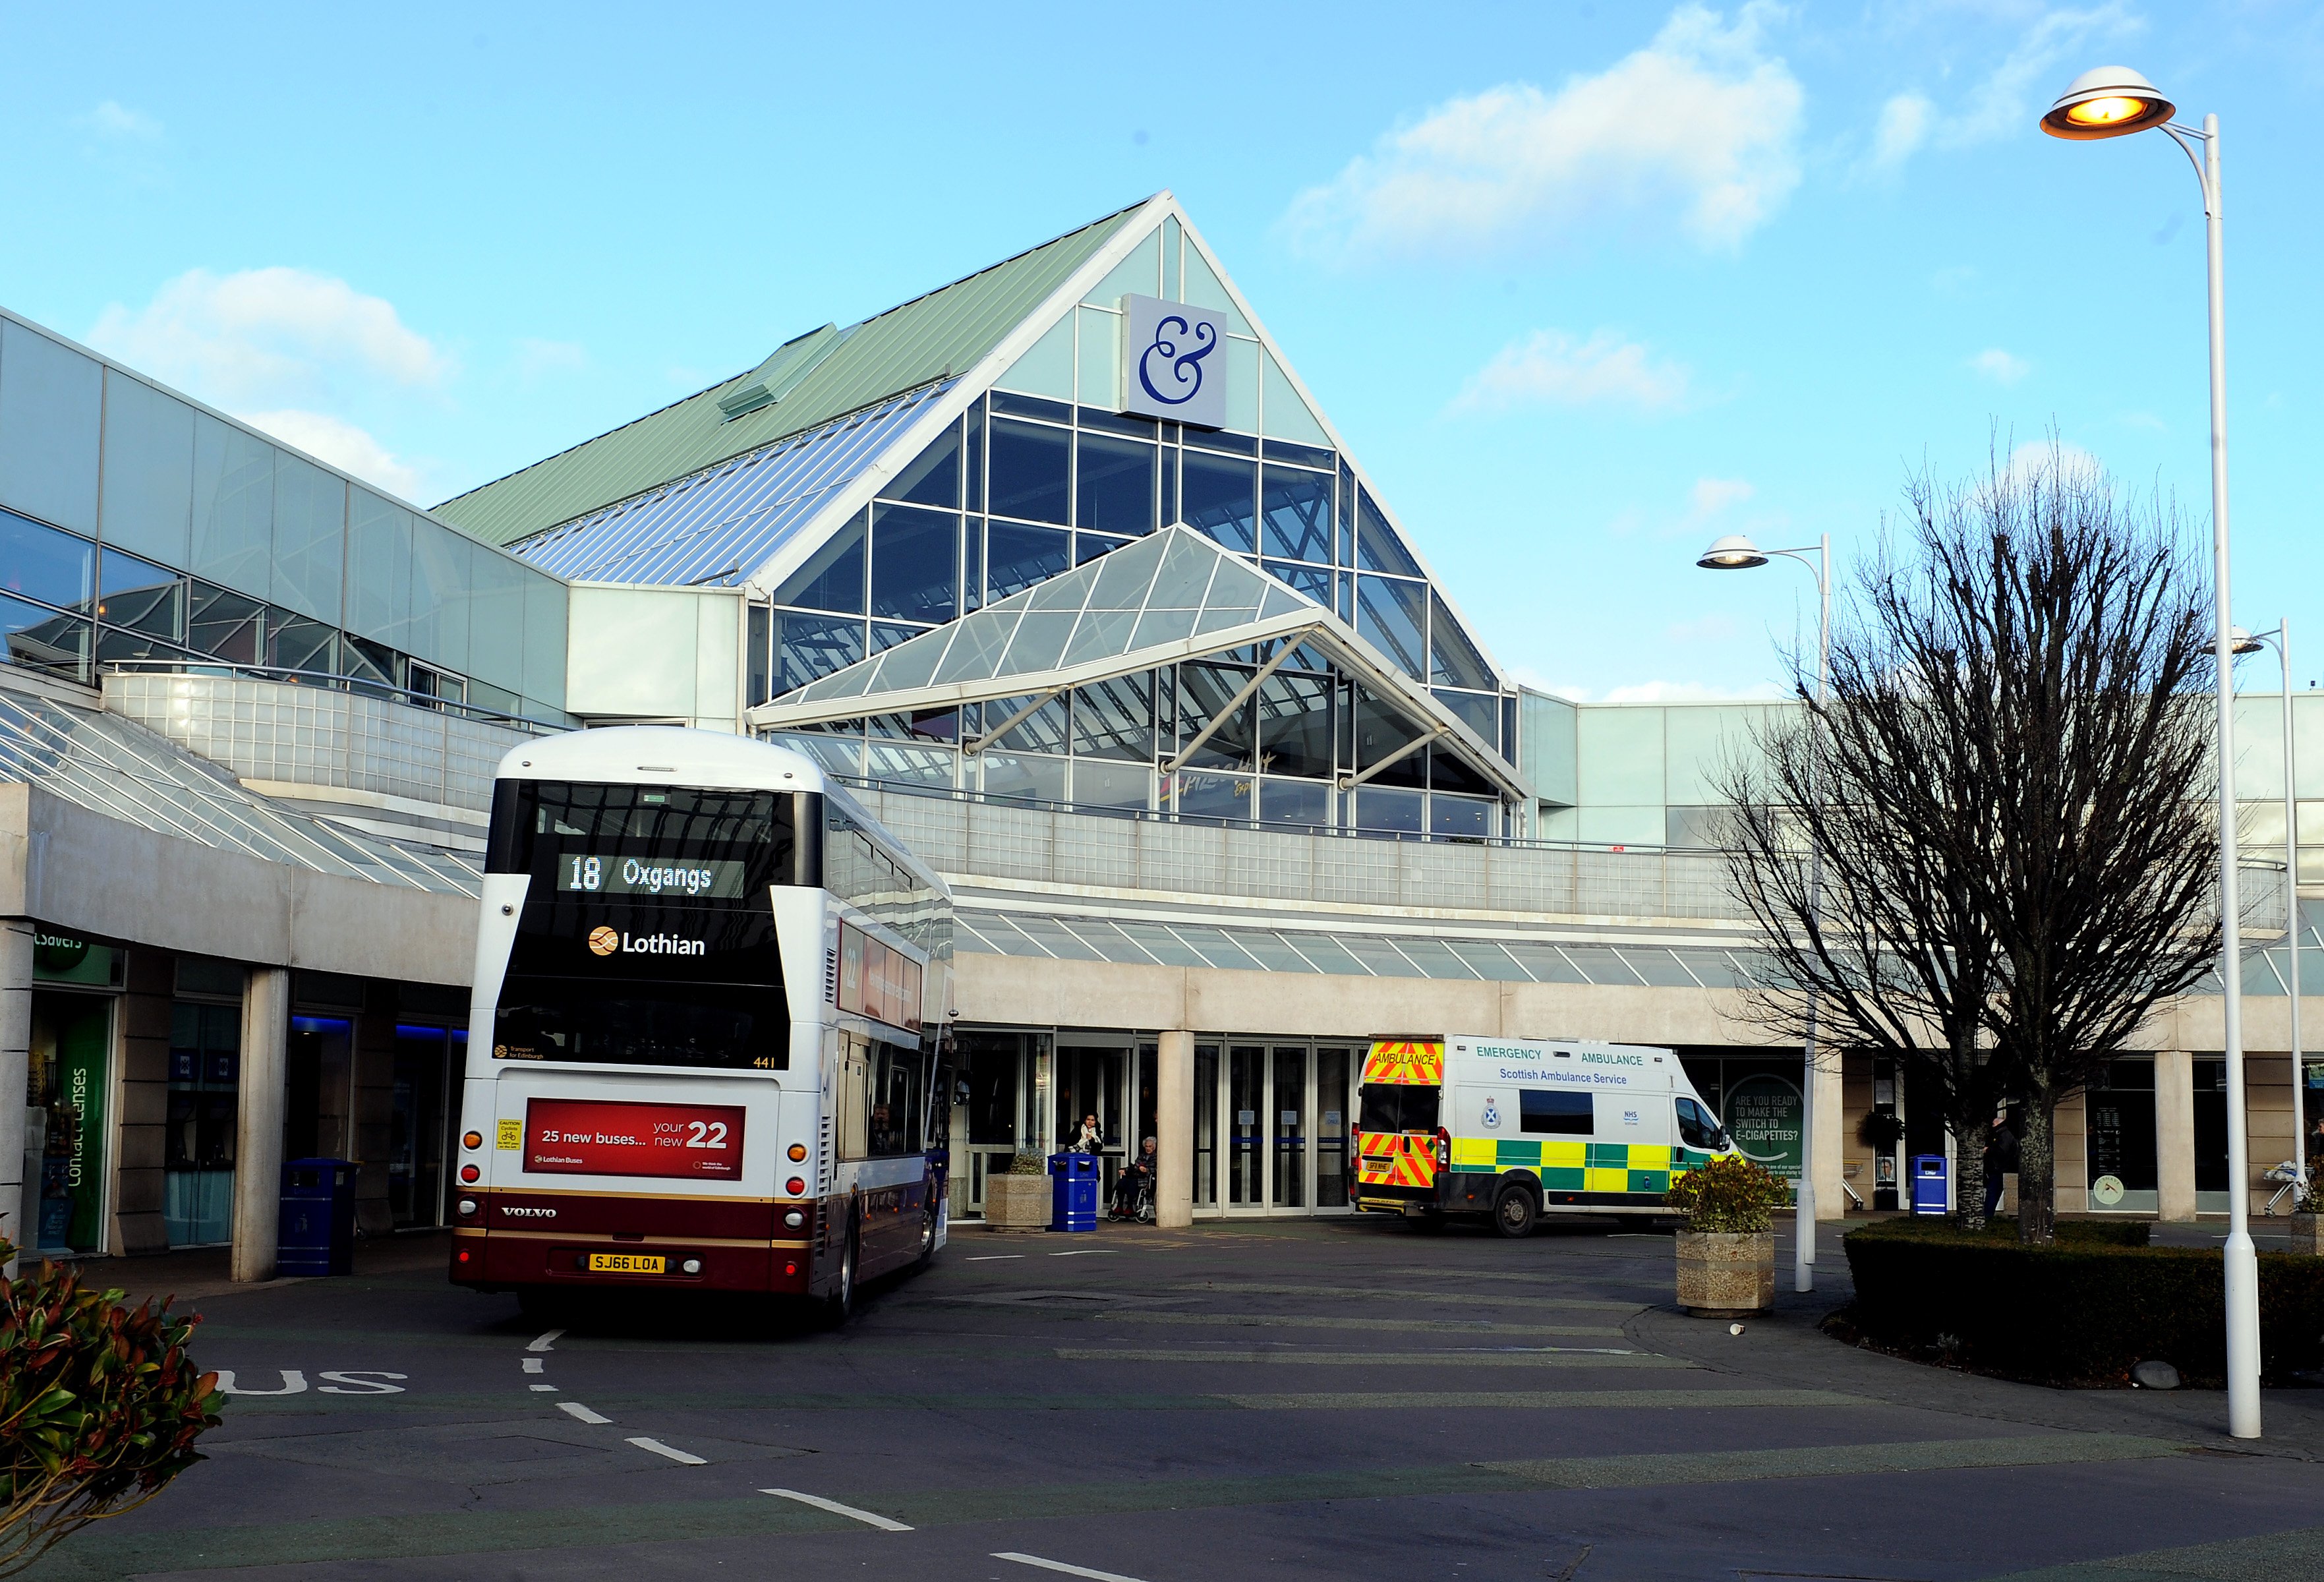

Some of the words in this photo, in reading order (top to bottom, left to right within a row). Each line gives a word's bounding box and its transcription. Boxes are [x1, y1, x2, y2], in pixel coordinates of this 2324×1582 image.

[569, 856, 601, 890] 18
[622, 858, 711, 894] Oxgangs
[622, 932, 705, 956] Lothian
[753, 1056, 774, 1069] 441
[1375, 1053, 1436, 1065] AMBULANCE
[1476, 1046, 1541, 1060] EMERGENCY
[1581, 1052, 1644, 1066] AMBULANCE
[1499, 1068, 1539, 1080] Scottish
[1540, 1070, 1592, 1083] Ambulance
[1594, 1073, 1627, 1085] Service
[1735, 1096, 1751, 1106] ARE
[1753, 1096, 1769, 1106] YOU
[1771, 1096, 1798, 1106] READY
[1735, 1107, 1745, 1117] TO
[1747, 1107, 1771, 1117] MAKE
[1772, 1107, 1787, 1117] THE
[1735, 1119, 1766, 1129] SWITCH
[1768, 1119, 1779, 1129] TO
[541, 1130, 559, 1142] 25
[563, 1132, 592, 1144] new
[595, 1132, 646, 1146] buses...
[653, 1122, 685, 1135] your
[685, 1121, 728, 1150] 22
[654, 1136, 683, 1148] new
[501, 1207, 557, 1218] VOLVO
[595, 1256, 629, 1270] SJ66
[633, 1257, 658, 1270] LOA
[196, 1370, 408, 1395] US
